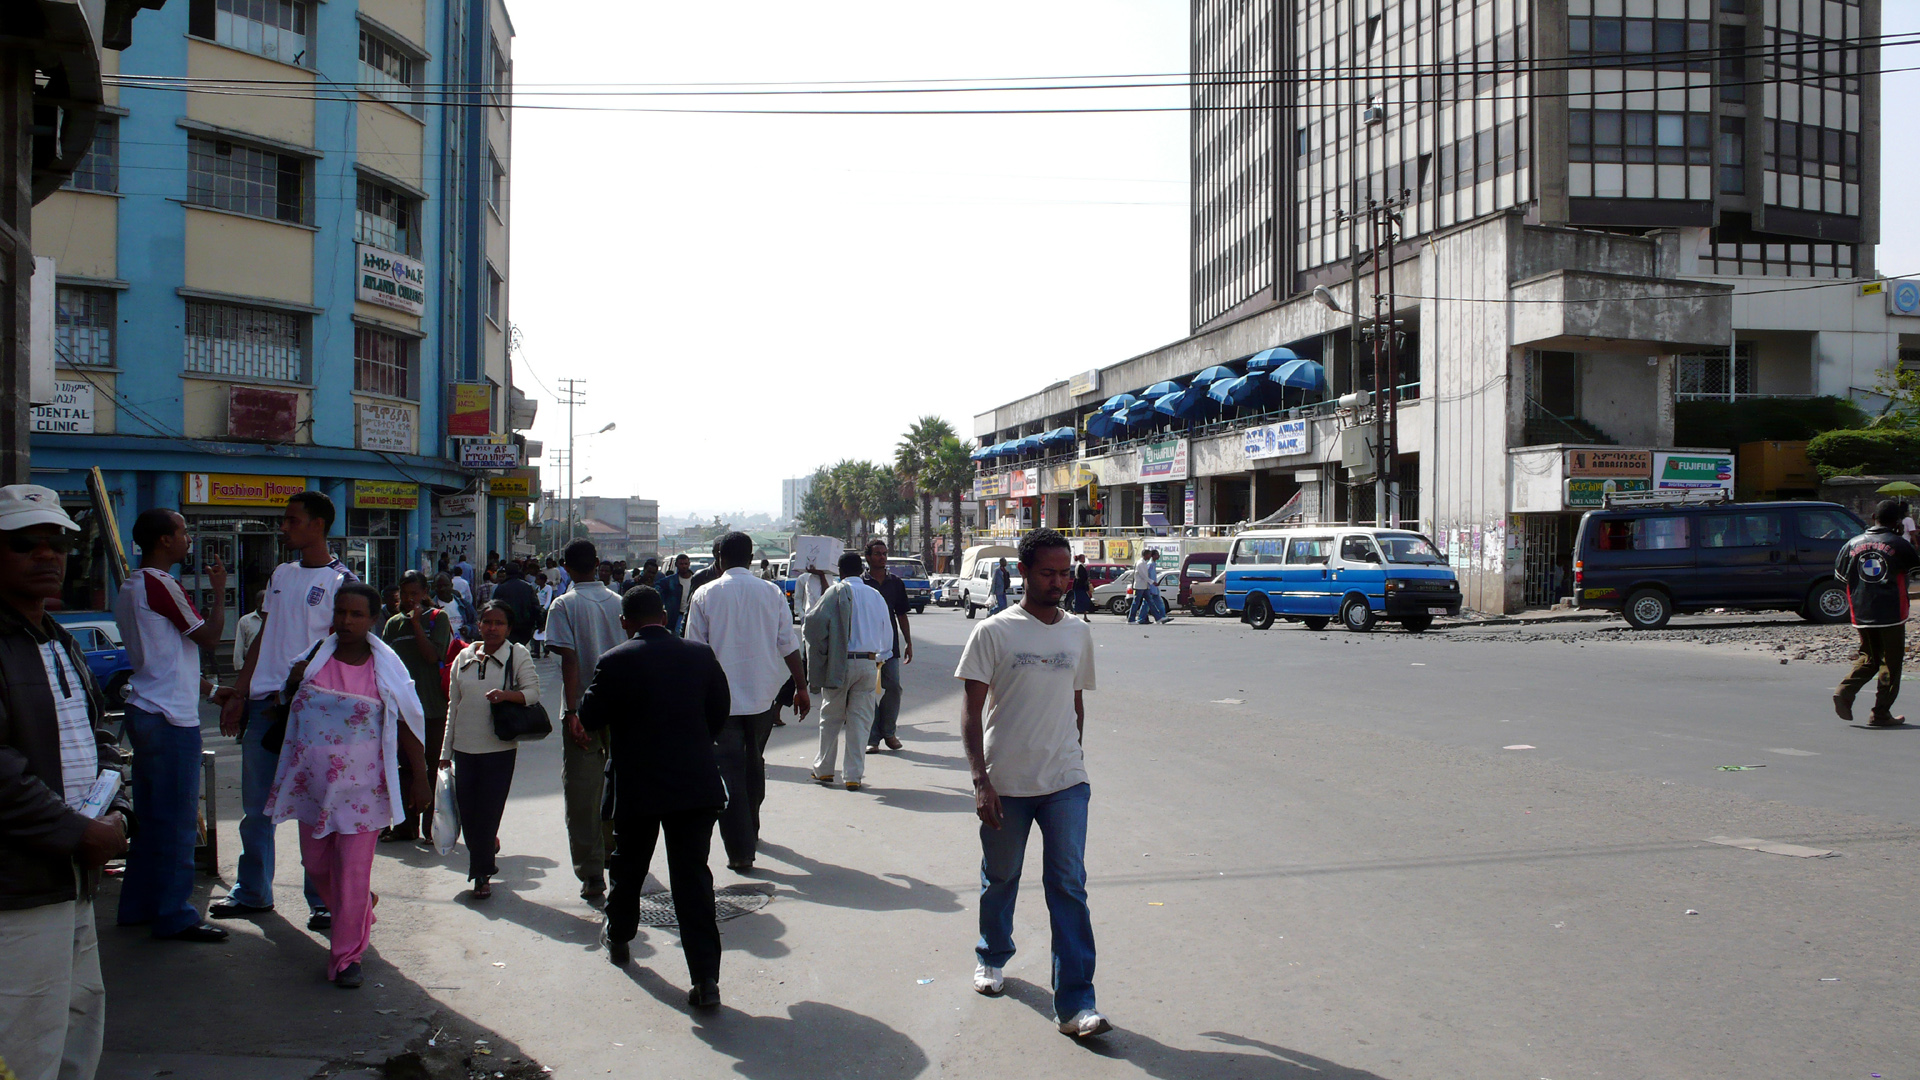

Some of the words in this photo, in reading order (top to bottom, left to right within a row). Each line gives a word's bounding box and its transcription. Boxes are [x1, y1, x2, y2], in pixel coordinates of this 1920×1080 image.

[363, 274, 396, 296] ATLANTA
[36, 406, 90, 420] DENTAL
[36, 420, 79, 432] CLINIC
[1278, 421, 1304, 434] AWASH
[1278, 438, 1298, 450] BANK
[1153, 445, 1175, 460] FUJIFILM
[1592, 452, 1647, 460] አምባሳደር
[1678, 461, 1715, 471] FUJIFILM
[212, 482, 262, 497] Fashion
[265, 482, 304, 499] House
